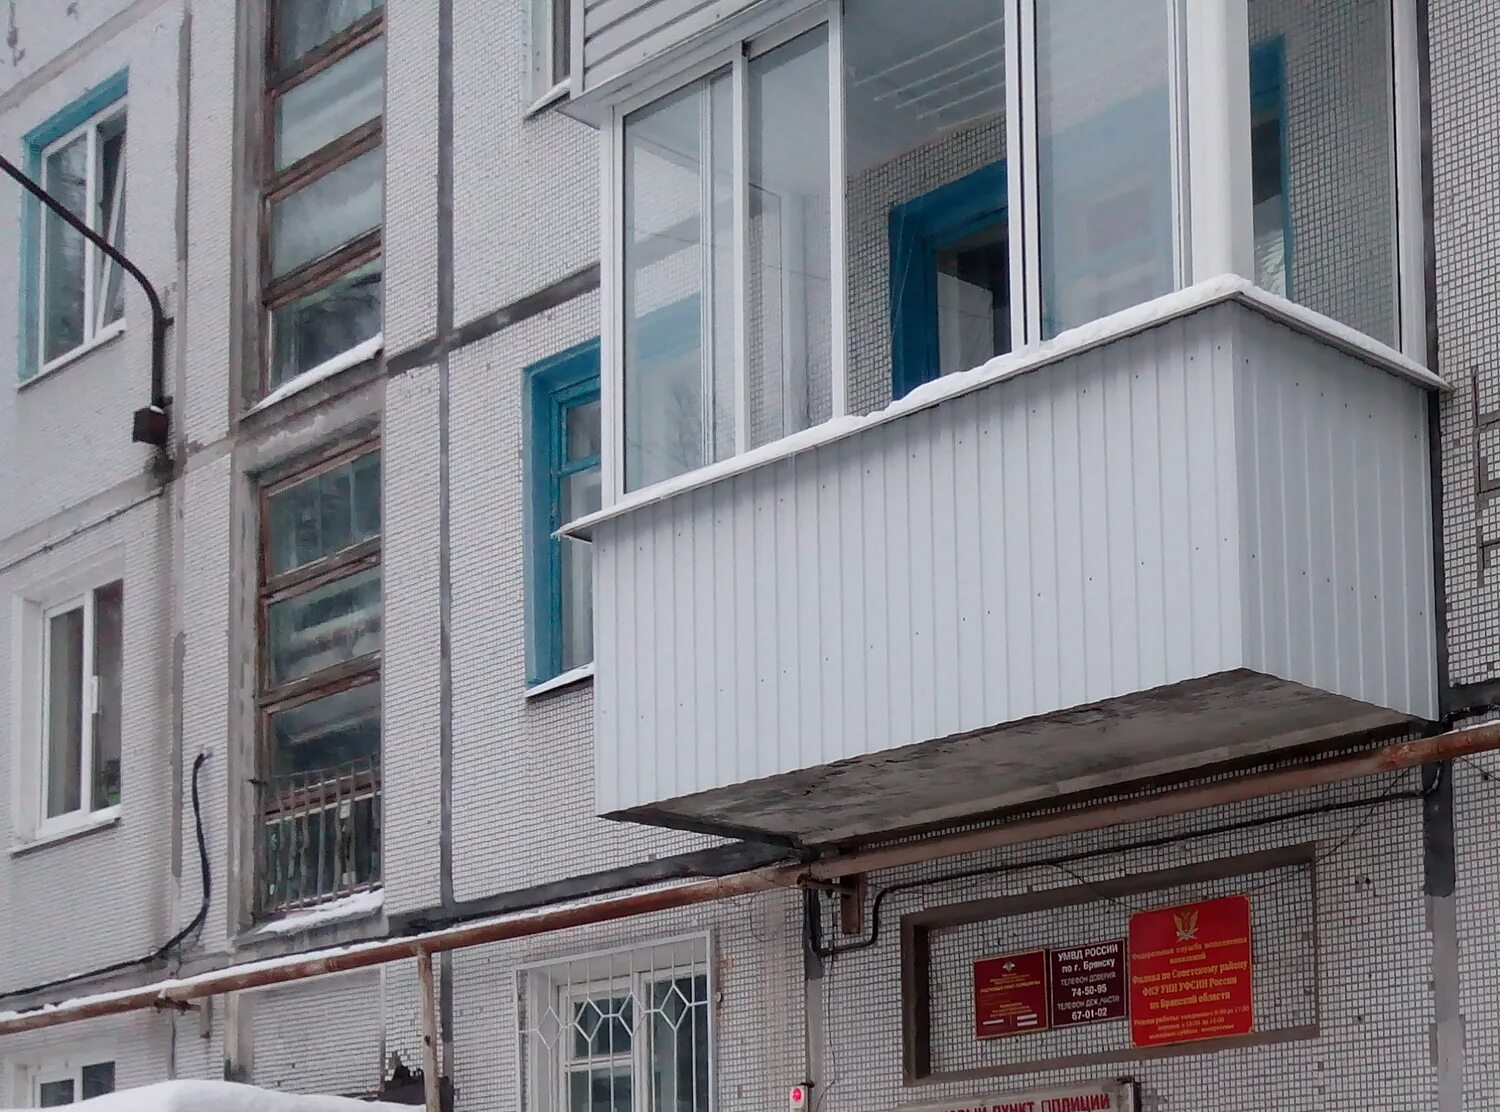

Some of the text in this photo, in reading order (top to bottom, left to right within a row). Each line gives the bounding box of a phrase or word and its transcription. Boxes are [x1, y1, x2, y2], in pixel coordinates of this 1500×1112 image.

[1058, 944, 1118, 962] УМВД РОССИИ
[1062, 965, 1072, 973] по
[1083, 958, 1116, 971] Брянску
[1072, 1008, 1108, 1021] 67-01-02
